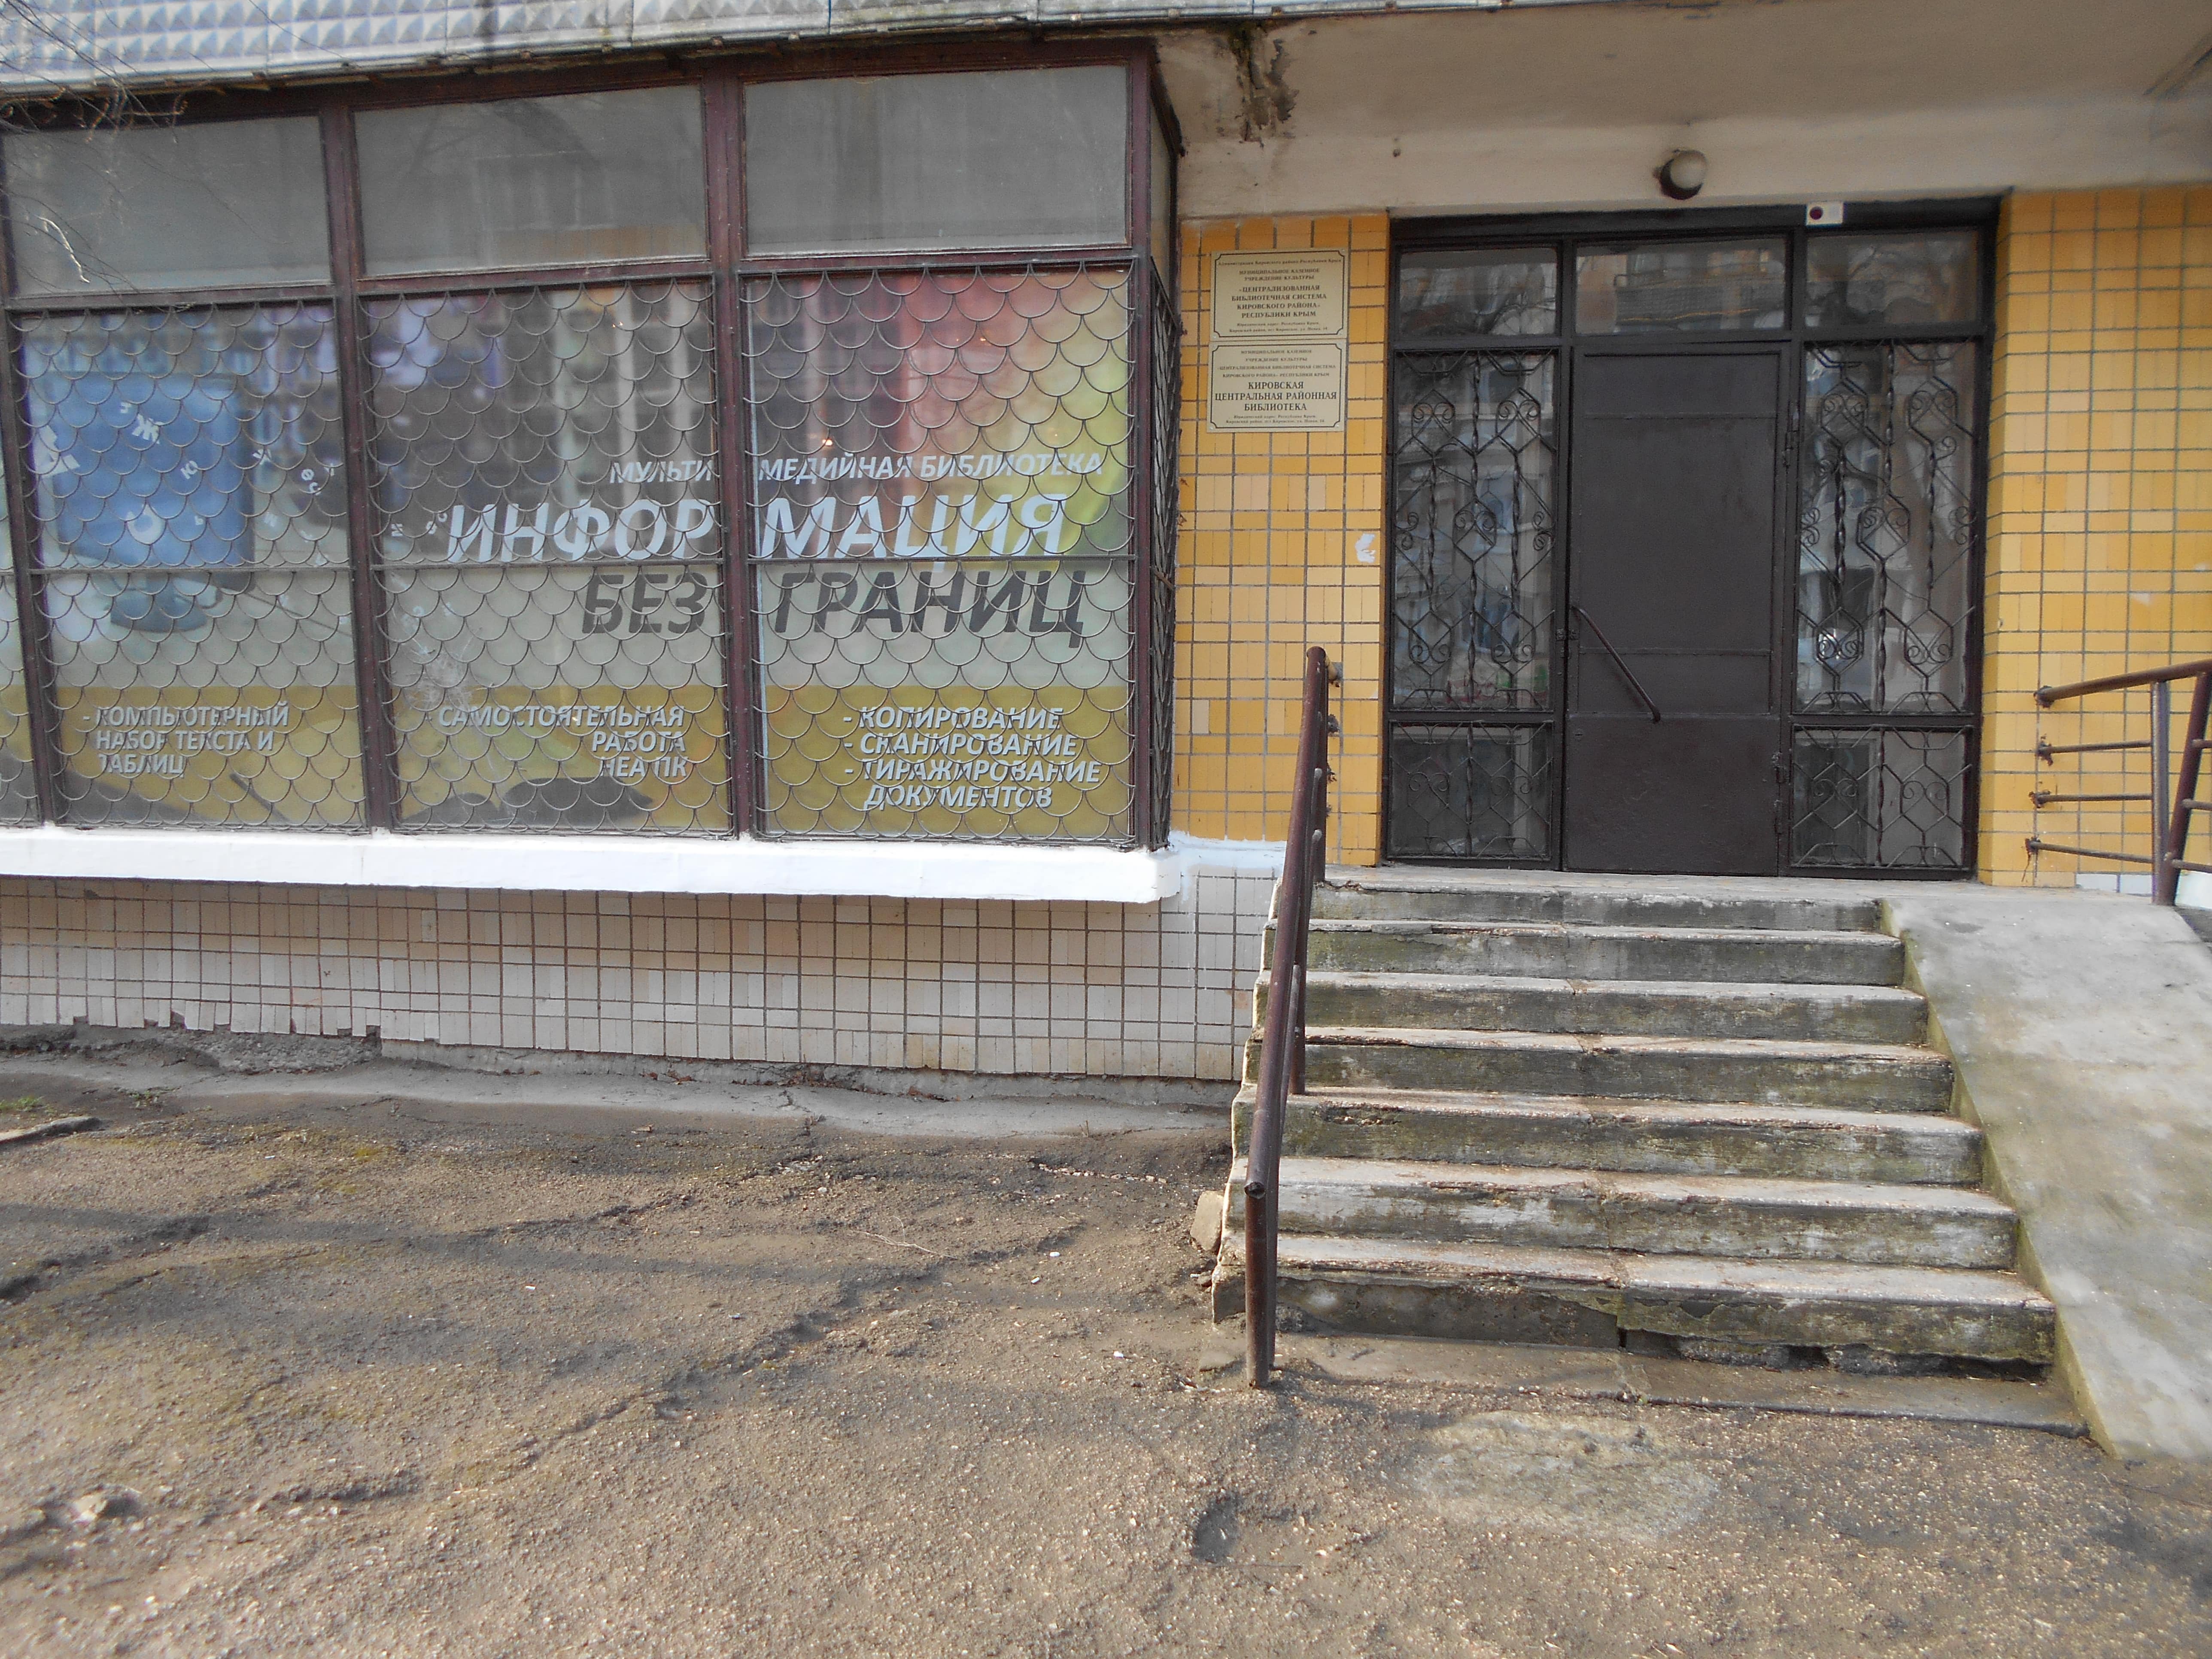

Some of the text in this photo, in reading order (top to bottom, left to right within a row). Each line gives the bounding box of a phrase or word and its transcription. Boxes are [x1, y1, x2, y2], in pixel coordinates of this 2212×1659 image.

[1215, 390, 1337, 401] ЦЕНТРАЛЬНАЯ РАЙОННАЯ
[1248, 381, 1304, 390] КИРОВСКАЯ
[1244, 403, 1307, 411] БИБЛИОТЕКА
[610, 452, 1103, 484] МУЛЬТИ МЕДИЙНАЯ БИБЛИОТЕКА
[448, 493, 1066, 574] ИНФОР МАЦИЯ
[582, 570, 1086, 649] БЕЗ ГРАНИЦ
[96, 701, 289, 727] КОМПЬЮТЕРНЫЙ
[438, 705, 685, 727] САМОСТОЯТЕЛЬНАЯ
[859, 706, 1064, 729] КОПИРОВАНИЕ
[97, 730, 276, 750] НАБОР ТЕКСТА И
[592, 730, 686, 752] РАБОТА
[860, 732, 1079, 756] СКАНИРОВАНИЕ
[98, 754, 185, 778] ТАБЛИЦ
[654, 756, 688, 777] ПК
[862, 758, 1102, 783] ТИРАЖИРОВАНИЕ
[863, 785, 1052, 811] ДОКУМЕНТОВ
